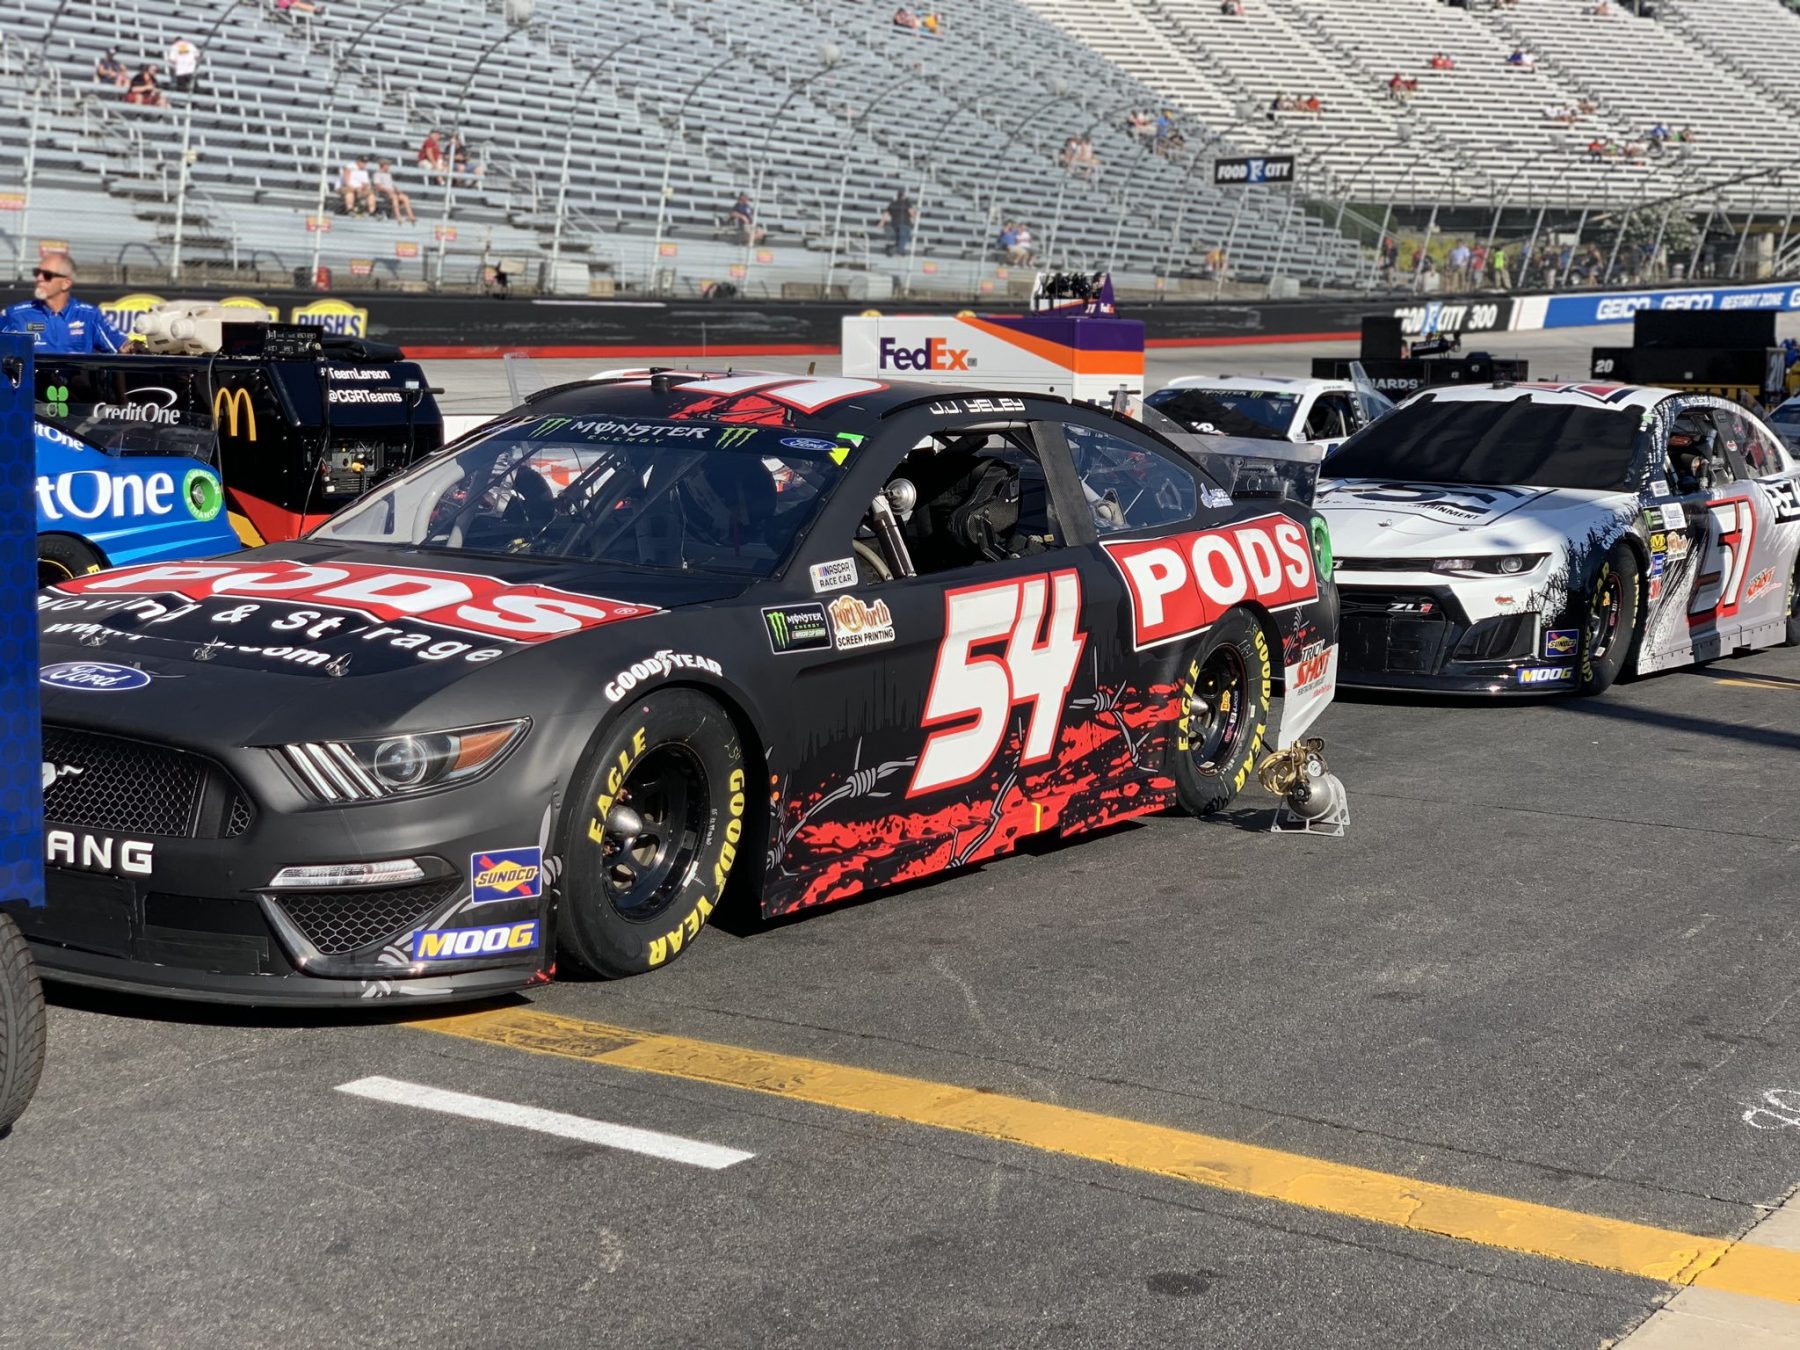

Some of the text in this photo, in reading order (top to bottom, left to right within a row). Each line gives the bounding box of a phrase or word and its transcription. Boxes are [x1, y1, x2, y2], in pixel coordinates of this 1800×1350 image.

[1217, 165, 1248, 179] FOOD
[1264, 162, 1291, 177] CITY
[1437, 305, 1468, 331] CITY
[1468, 304, 1498, 330] 300
[1596, 296, 1650, 320] GEICO
[880, 337, 969, 371] FedEx
[1595, 360, 1614, 373] 20
[328, 389, 402, 403] @CGRTeams
[966, 398, 1026, 413] YELEY
[94, 401, 181, 425] CreditOne
[34, 421, 85, 451] itOne
[570, 420, 711, 439] MONSTER
[587, 435, 664, 444] ENERGY
[787, 438, 830, 450] Ford
[825, 561, 850, 577] NASCAR
[1123, 524, 1312, 628] PODS
[819, 574, 853, 588] RACE CAR
[85, 565, 607, 634] PODS
[1387, 603, 1433, 614] ZL1
[786, 612, 824, 625] MONSTER
[211, 604, 261, 623] &
[271, 610, 503, 663] Strage
[837, 634, 864, 647] SCREEN
[863, 628, 894, 642] PRINTING
[49, 664, 131, 687] Ford
[604, 650, 723, 702] GOODYEAR
[910, 571, 1085, 793] 54
[1520, 667, 1573, 683] MOOG
[1178, 660, 1200, 751] EAGLE
[588, 726, 646, 845] EAGLE
[477, 867, 537, 886] SUNOCO
[417, 922, 536, 958] MOOG
